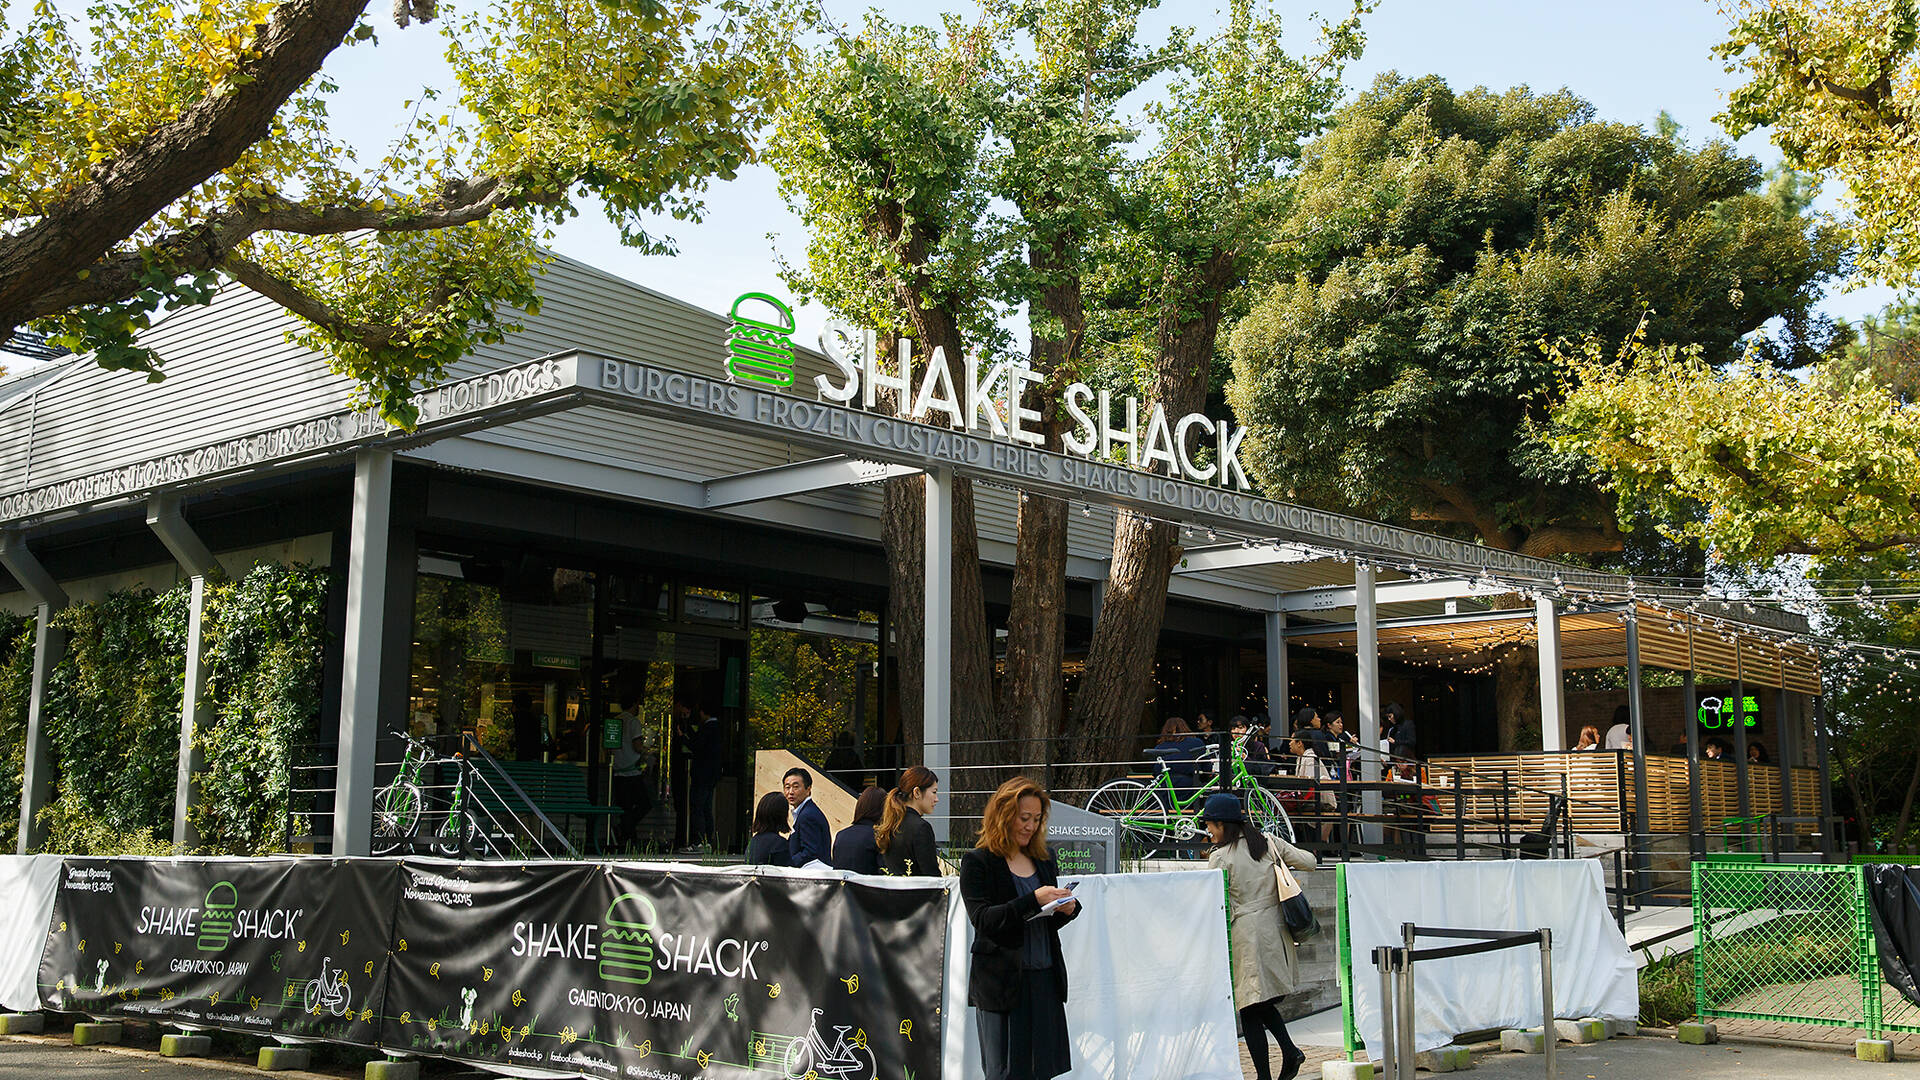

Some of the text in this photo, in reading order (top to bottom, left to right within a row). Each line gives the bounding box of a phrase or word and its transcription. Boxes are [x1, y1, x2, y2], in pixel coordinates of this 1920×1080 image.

[814, 320, 1250, 490] SHAKE SHACK
[0, 491, 34, 521] OGS
[193, 438, 252, 475] CONES
[257, 415, 340, 460] BURGERS
[350, 394, 428, 438] SHAS
[437, 379, 489, 416] HOT
[489, 360, 561, 405] DOGS
[602, 358, 742, 416] BURGERS
[756, 392, 865, 441] FROZEN
[872, 418, 982, 464] CUSTARD
[992, 445, 1050, 478] FRIES
[1062, 460, 1139, 495] SHAKES
[1149, 477, 1193, 504] HOT
[1191, 486, 1242, 518] DOGS
[1250, 500, 1347, 538] CONCRETES
[1354, 521, 1407, 550] FLOATS
[1413, 534, 1457, 561] CONES
[1463, 543, 1519, 571] BURGERS
[1049, 825, 1114, 837] SHAKE SHACK
[1057, 848, 1091, 860] Grand
[69, 867, 112, 881] Grand Opening
[411, 872, 470, 892] Grand Opening
[64, 880, 91, 890] November
[404, 887, 443, 903] November
[452, 893, 474, 907] 2015
[137, 906, 199, 936] SHAKE
[510, 922, 597, 961] SHAKE
[225, 961, 249, 976] JAPAN
[650, 1000, 692, 1023] JAPAN
[508, 1047, 543, 1061] shakeshack.jp
